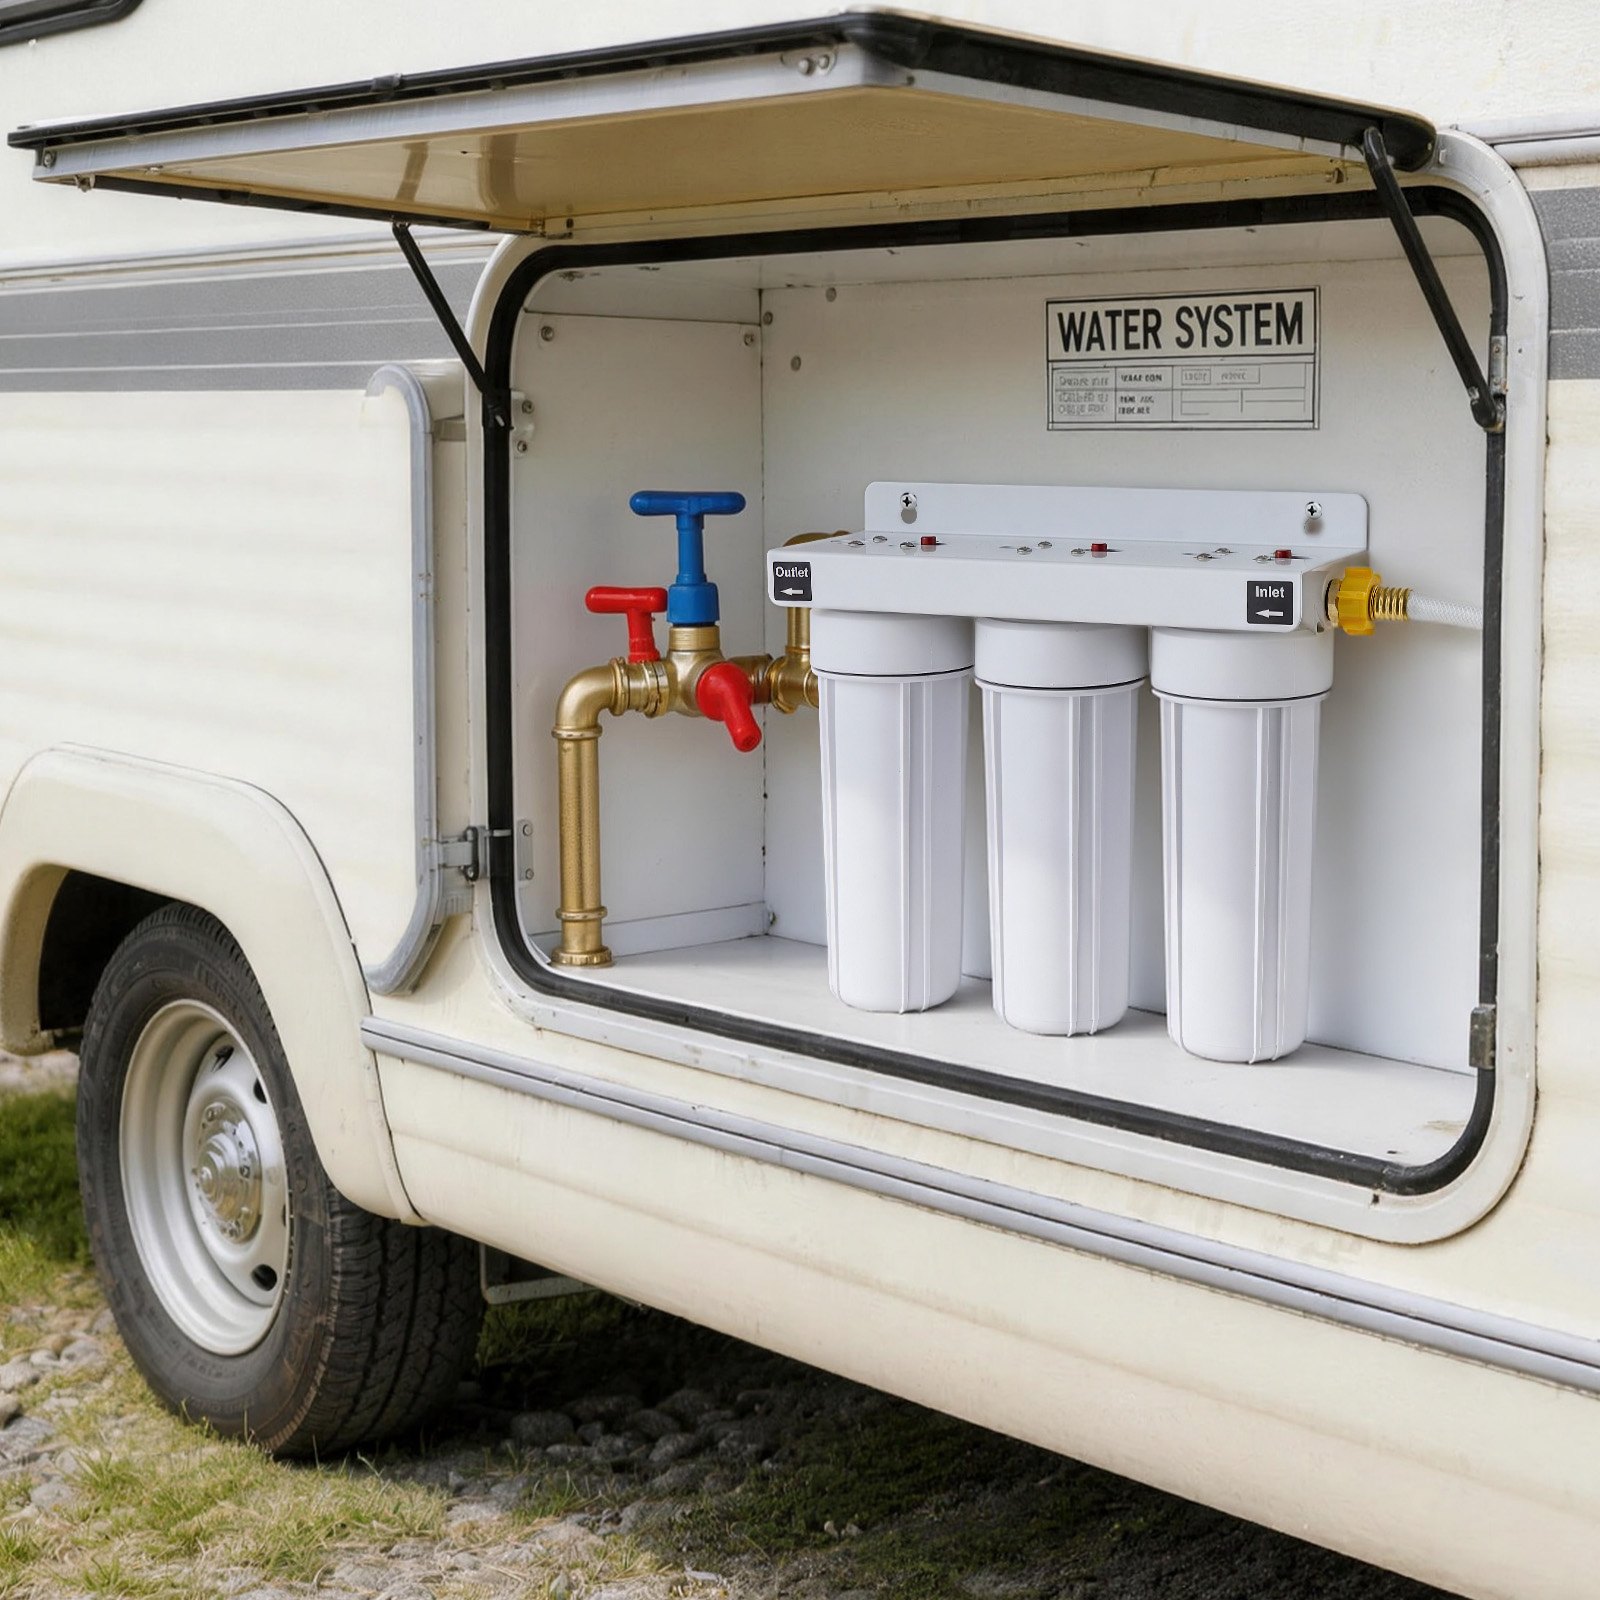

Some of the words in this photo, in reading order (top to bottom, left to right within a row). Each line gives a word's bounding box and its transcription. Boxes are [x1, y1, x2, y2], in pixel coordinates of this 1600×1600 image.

[1057, 308, 1162, 352] WATER
[1175, 301, 1304, 349] SYSTEM
[775, 566, 809, 578] Outlet
[1255, 585, 1285, 598] Inlet
